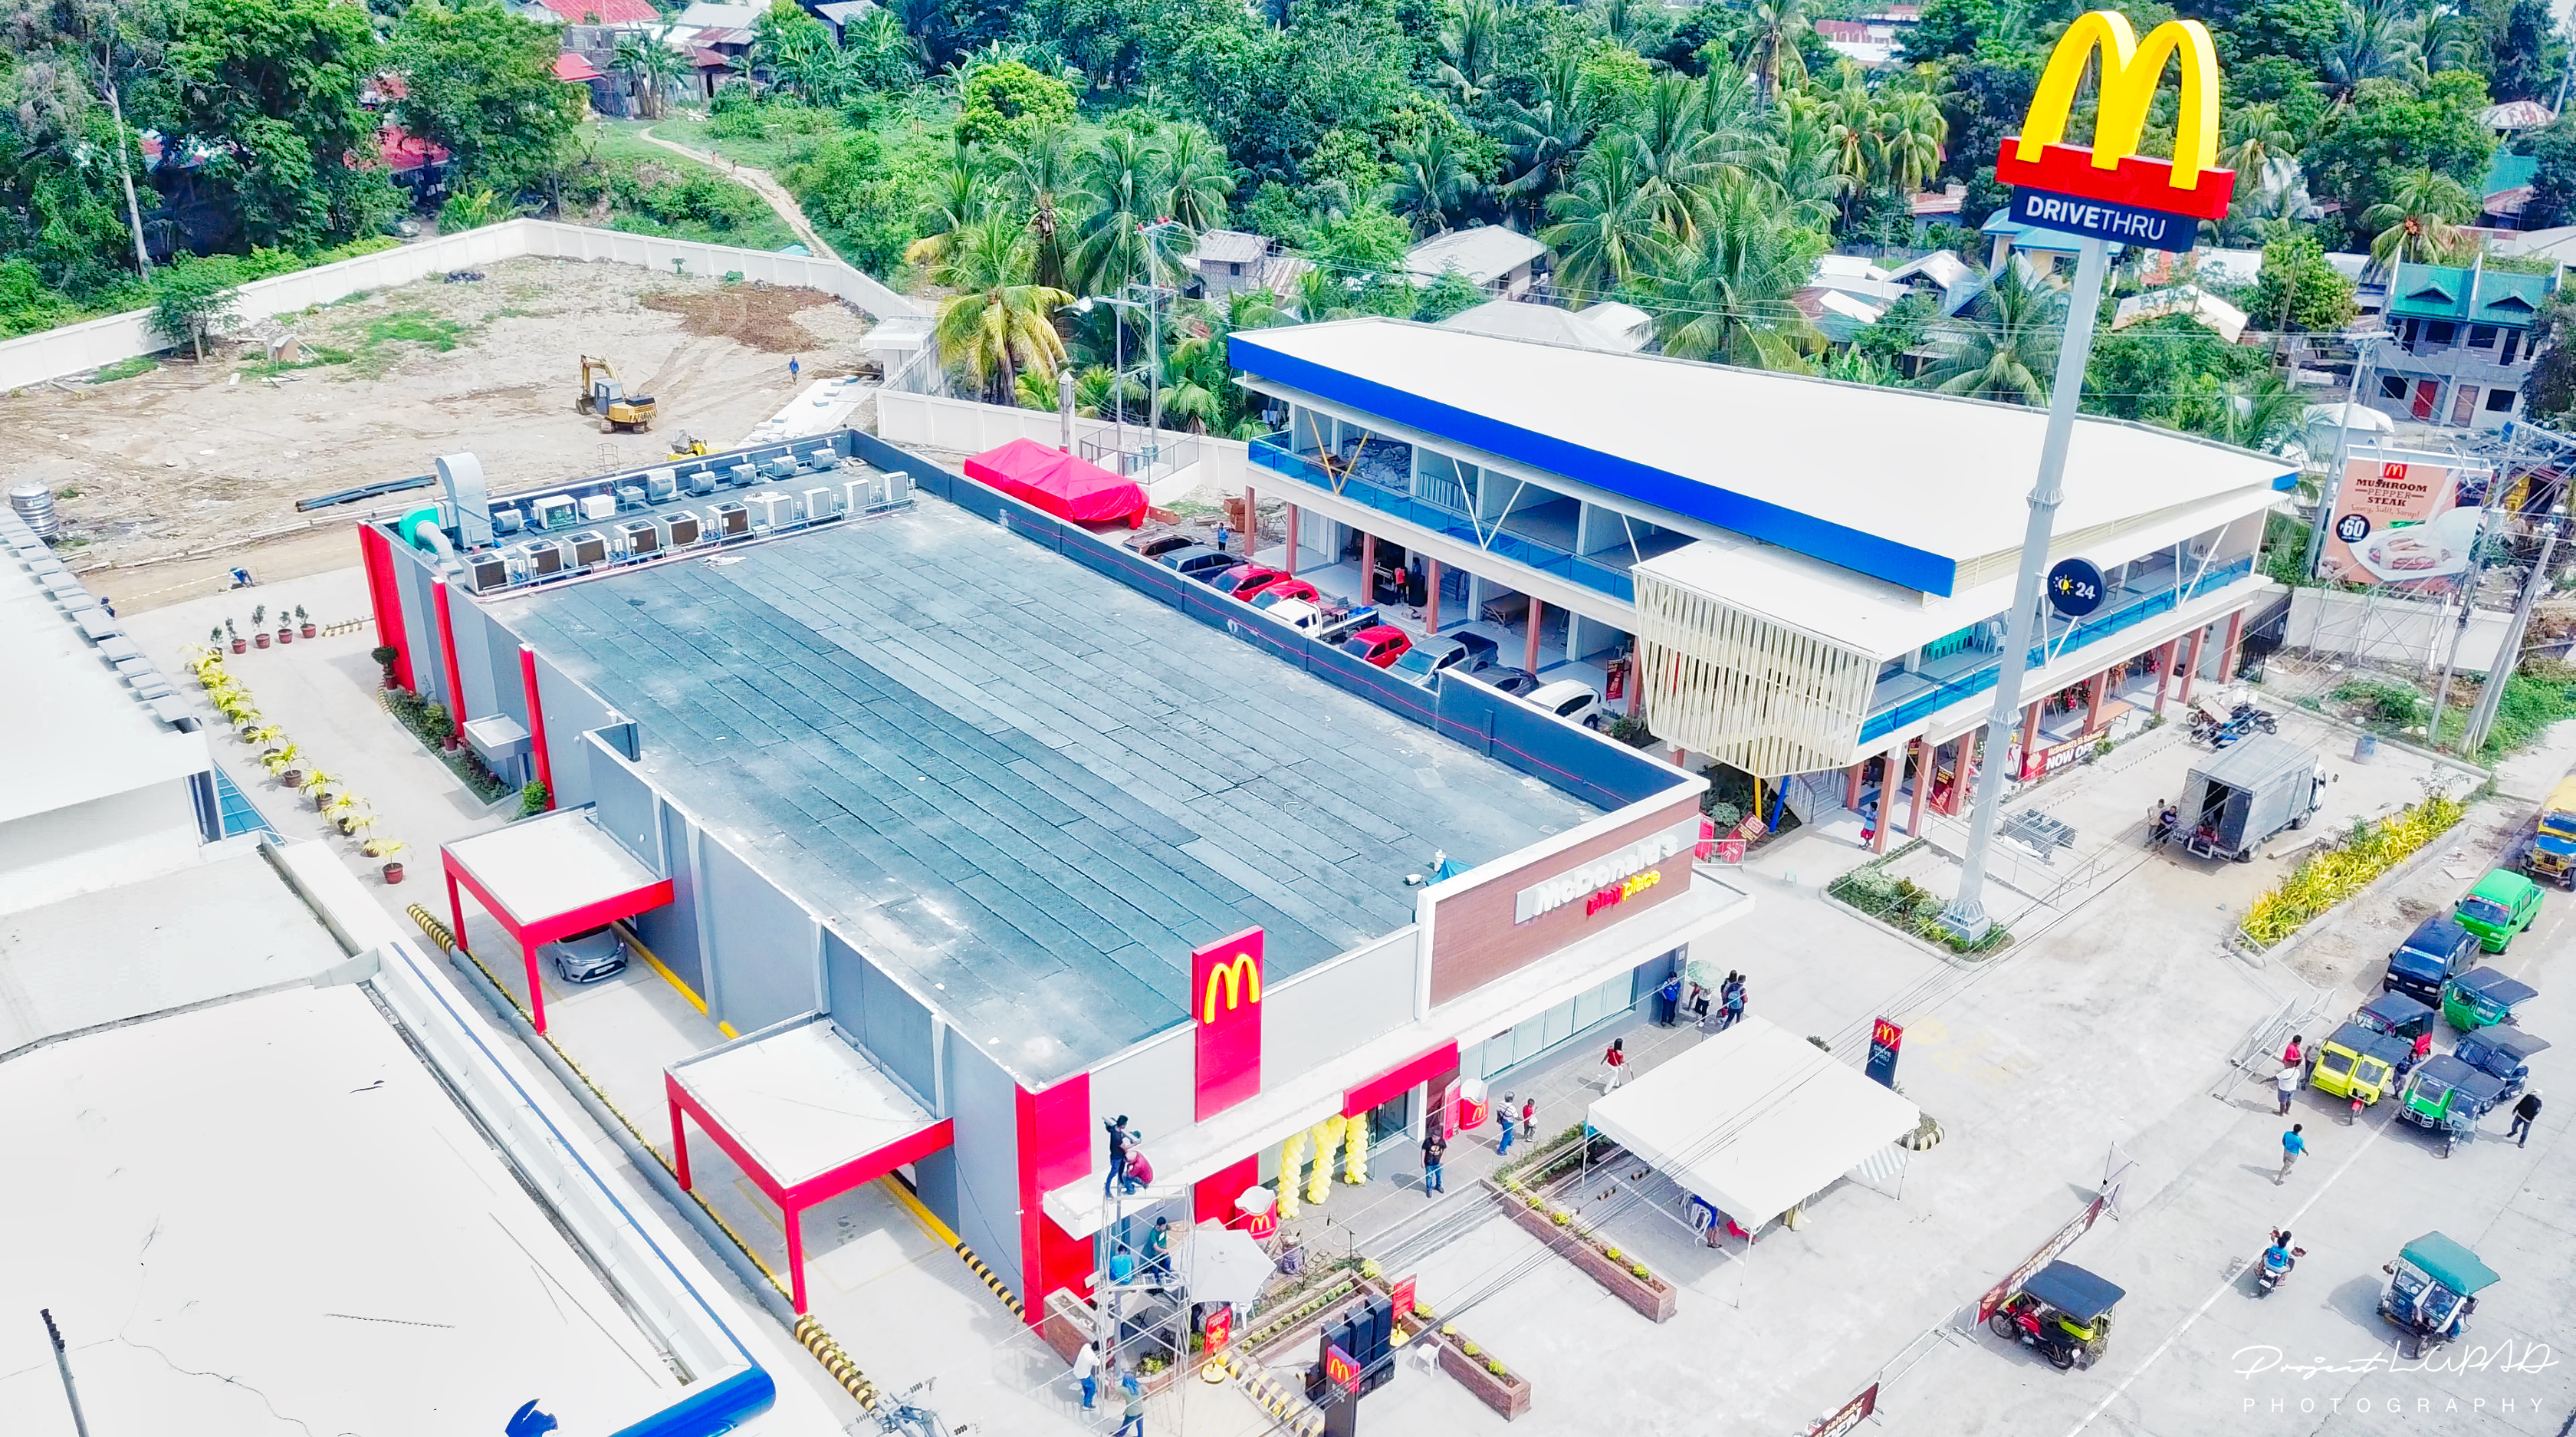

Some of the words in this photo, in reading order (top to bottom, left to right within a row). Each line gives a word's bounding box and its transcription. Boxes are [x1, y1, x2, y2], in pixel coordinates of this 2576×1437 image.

[2026, 195, 2167, 241] DRIVETHRU
[2355, 478, 2428, 492] MUSHROOM
[2367, 488, 2411, 499] PEPPER
[2367, 496, 2407, 507] STEAK
[2075, 581, 2096, 600] 24
[2045, 748, 2074, 771] NOW
[2074, 737, 2101, 758] OPE
[1533, 834, 1678, 916] McDonald's
[2049, 1218, 2088, 1259] OPEN
